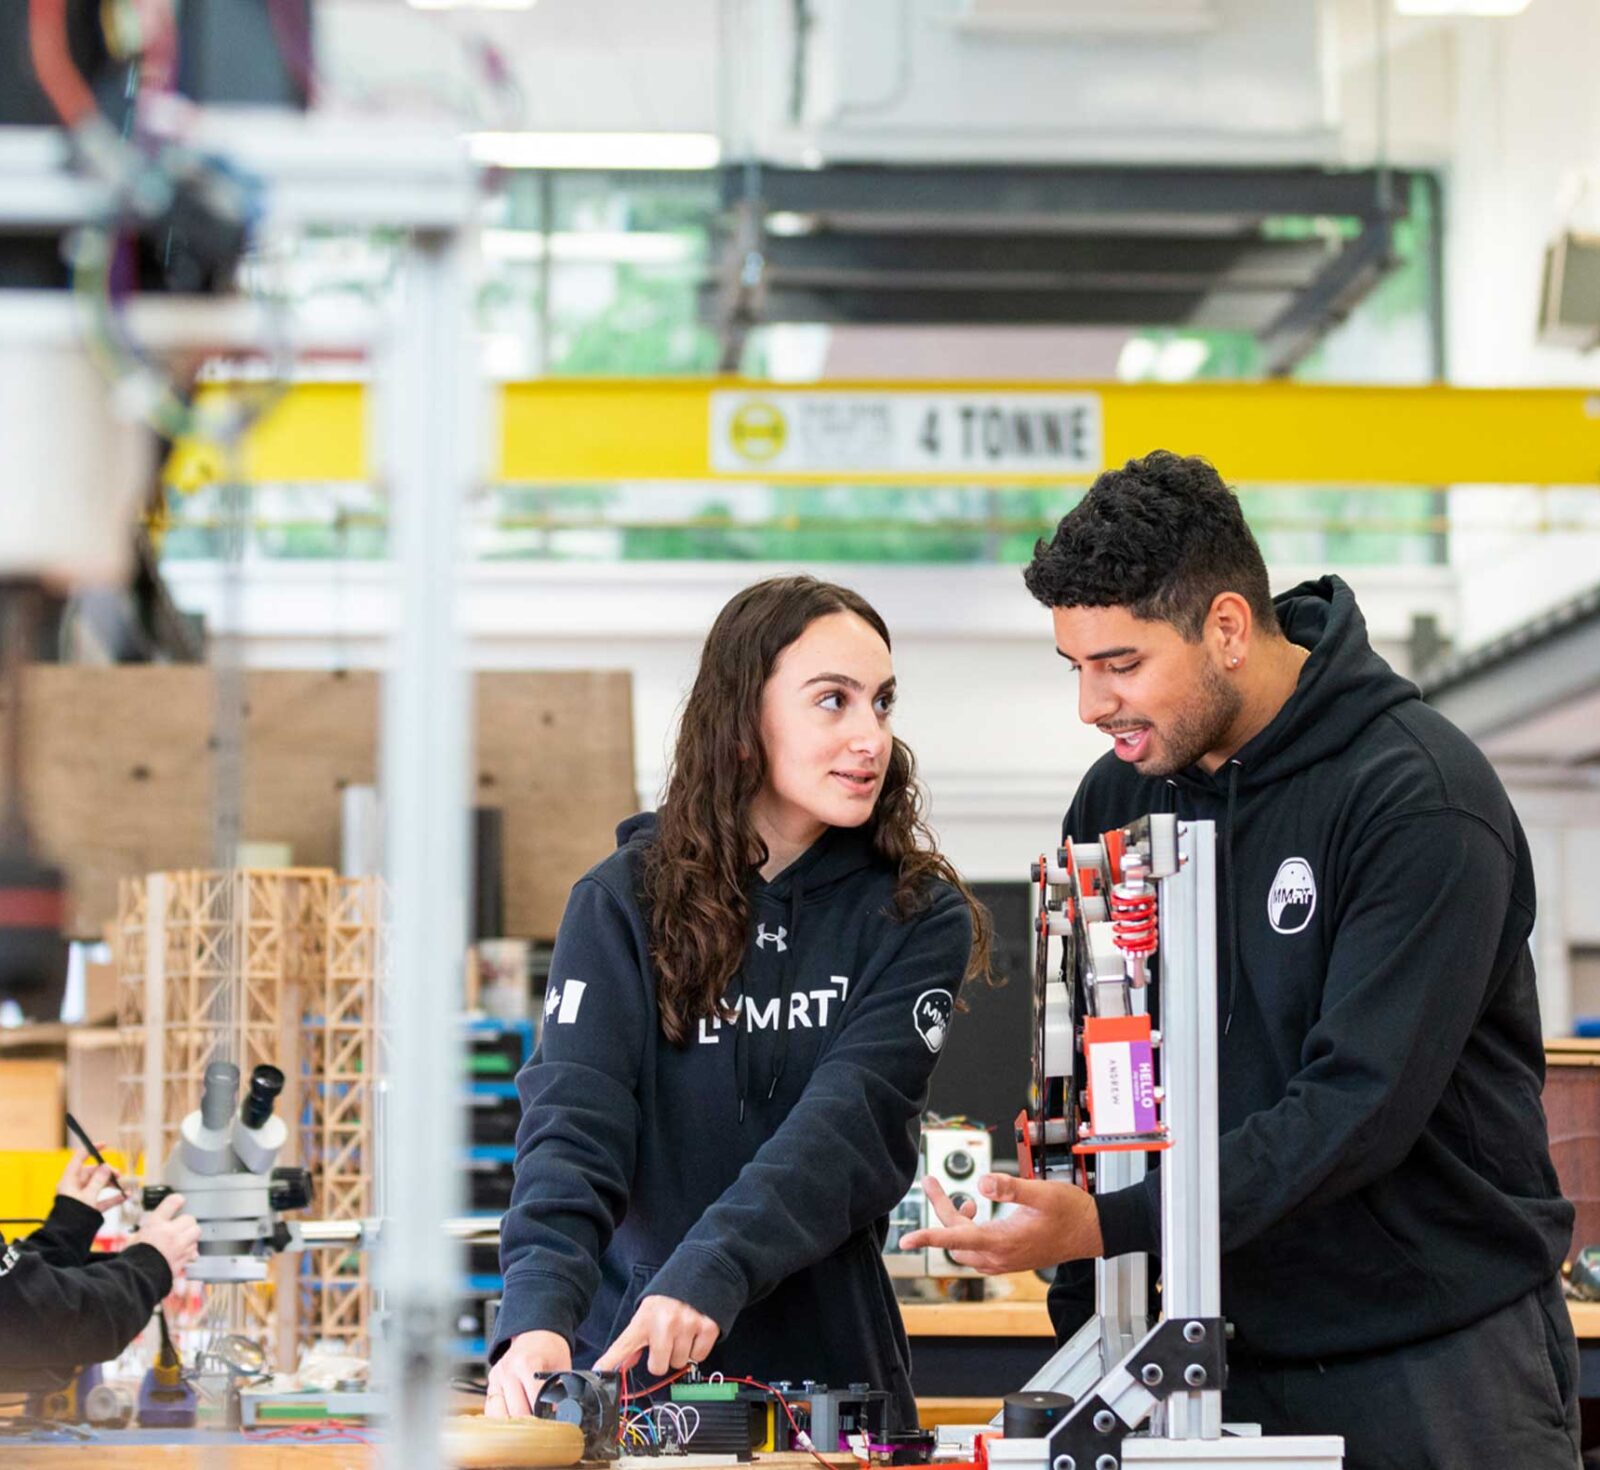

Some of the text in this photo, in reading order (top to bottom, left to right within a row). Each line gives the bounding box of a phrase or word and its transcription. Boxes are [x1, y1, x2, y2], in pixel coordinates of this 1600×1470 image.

[917, 406, 941, 459] 4
[956, 405, 1090, 460] TONNE
[1109, 1059, 1120, 1105] ANDREW
[1139, 1062, 1153, 1108] HELLO
